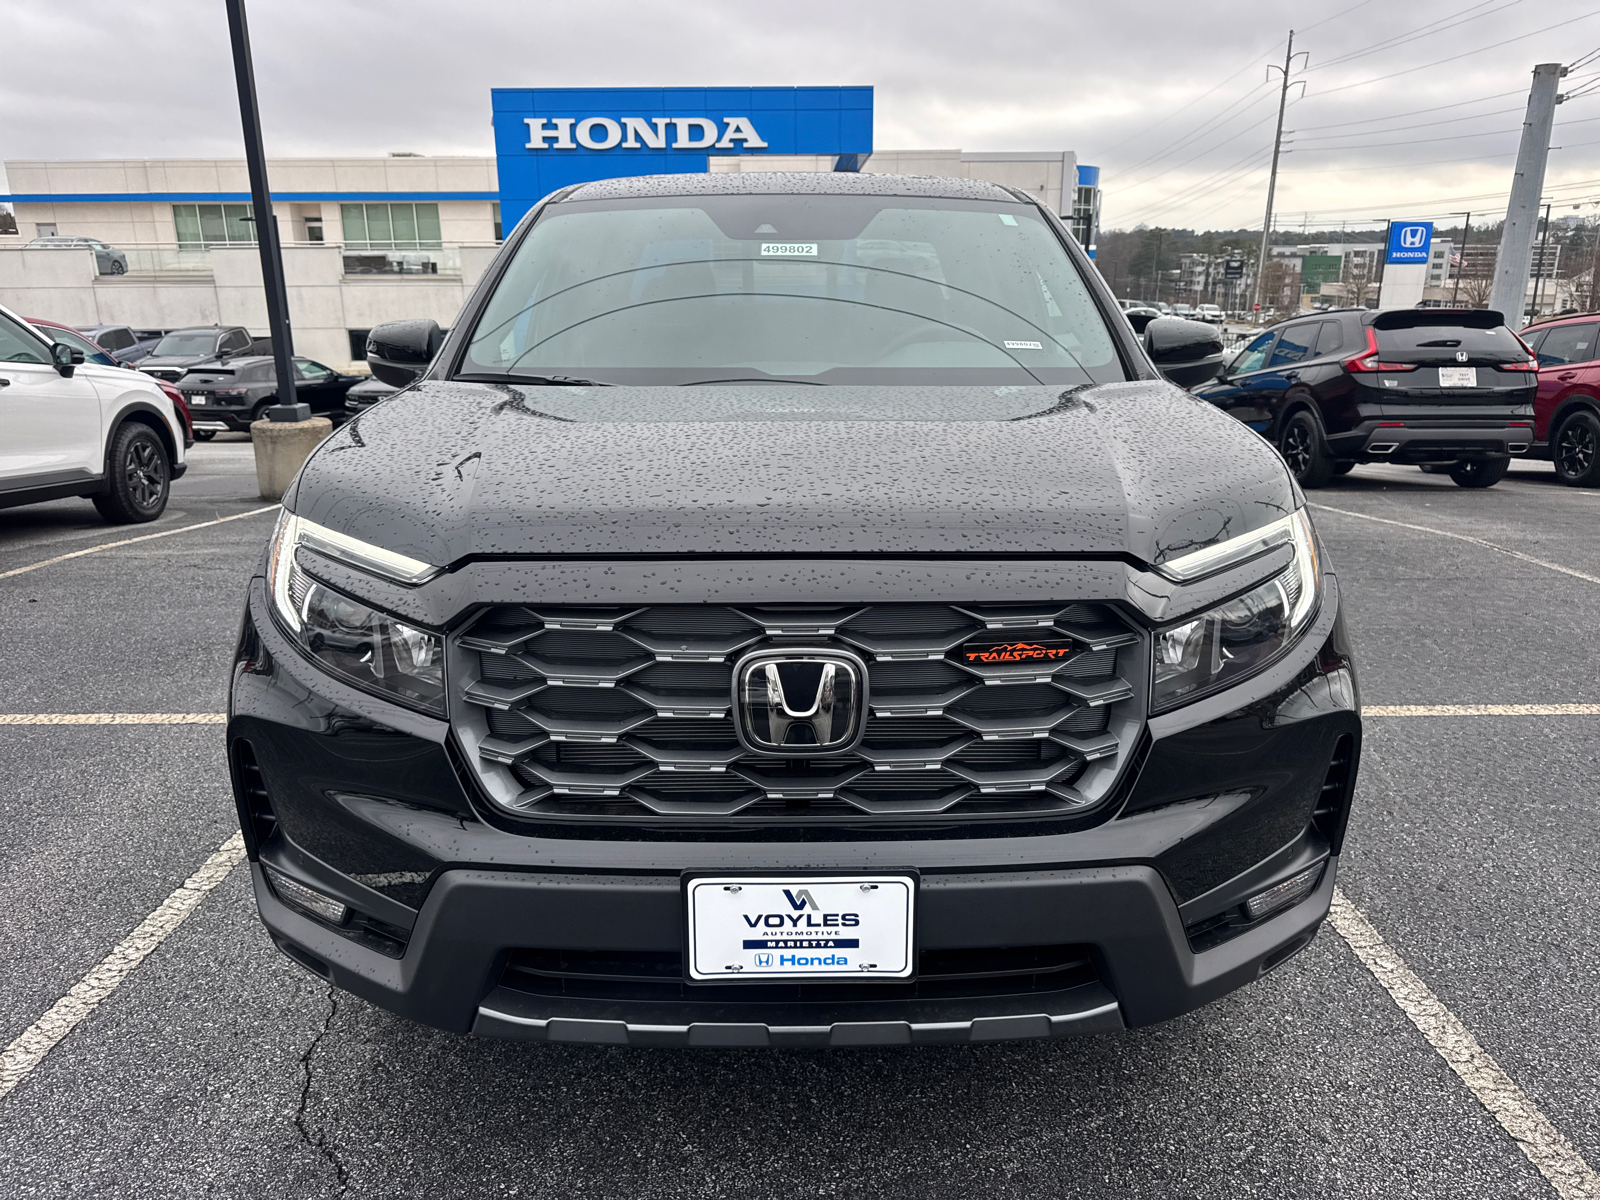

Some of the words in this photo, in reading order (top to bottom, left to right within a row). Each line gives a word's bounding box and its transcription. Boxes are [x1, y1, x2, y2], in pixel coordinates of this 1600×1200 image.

[523, 117, 768, 149] HONDA
[763, 245, 813, 254] 499802
[966, 648, 1070, 662] TRAILSPORT
[742, 913, 860, 928] VOYLES
[767, 940, 835, 948] MARIETTA
[779, 954, 848, 966] Honda
